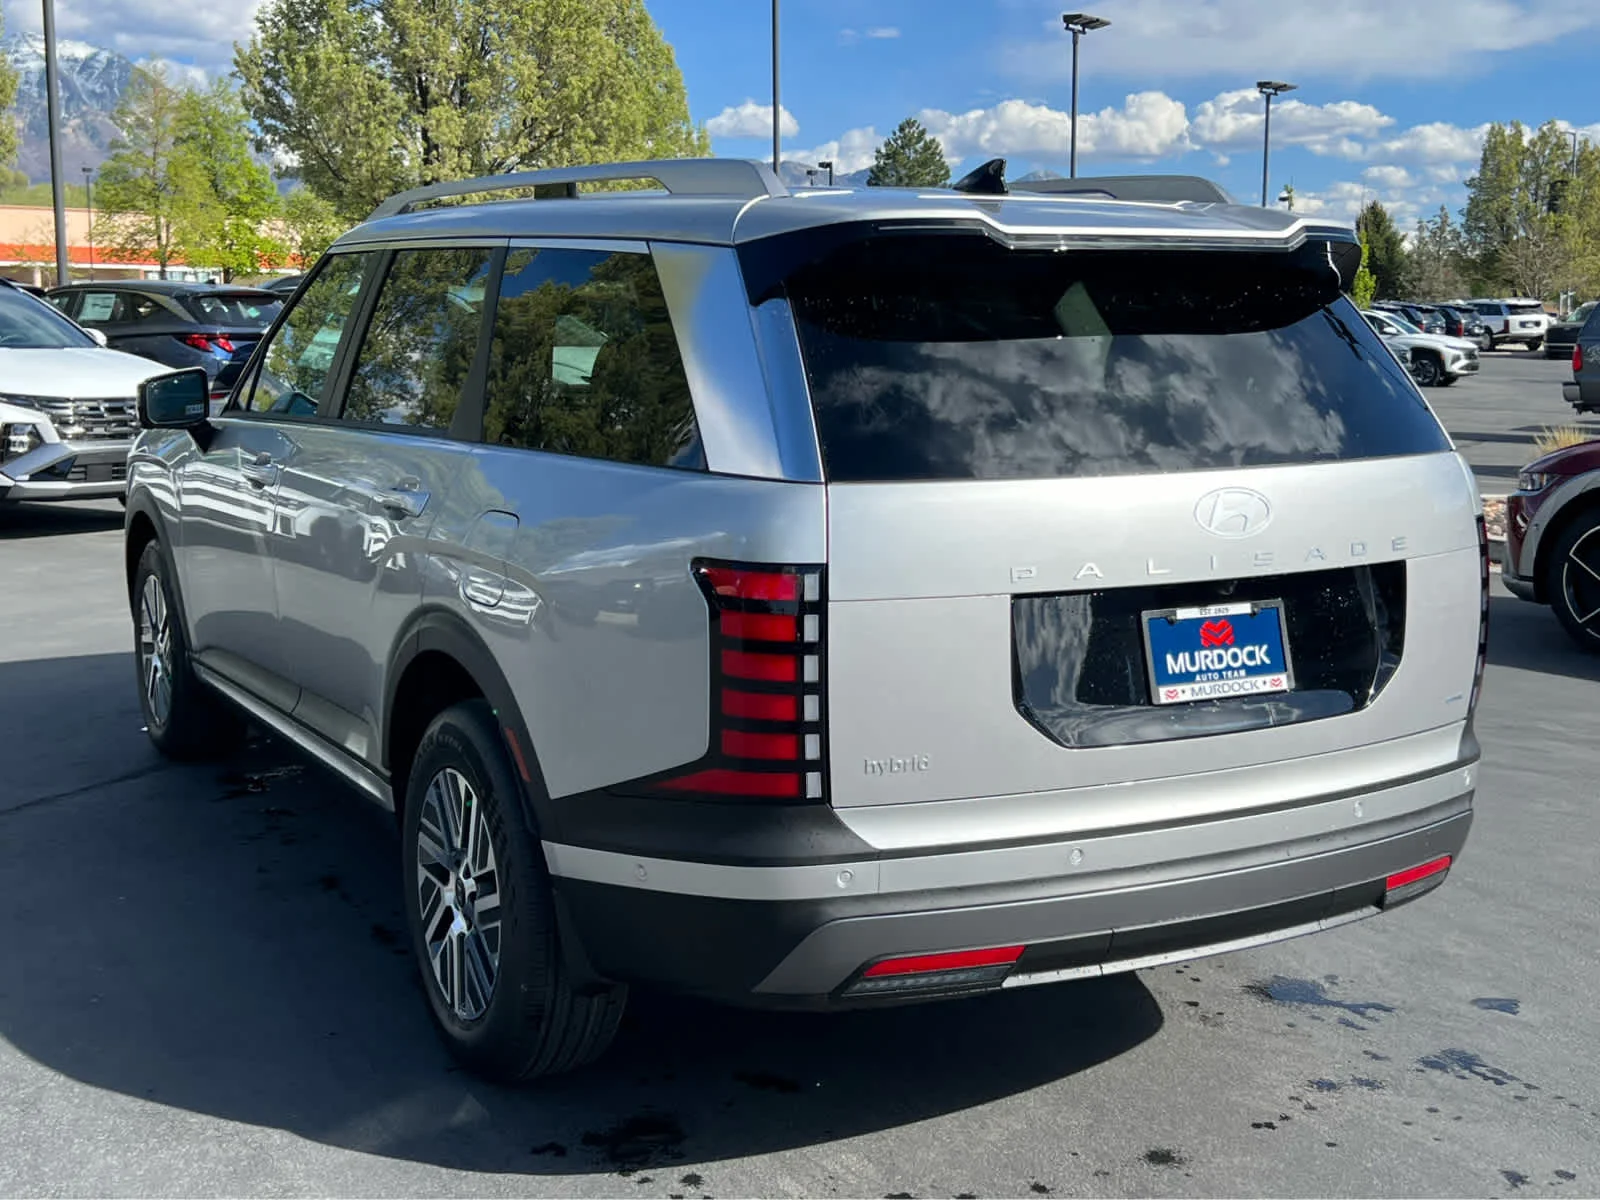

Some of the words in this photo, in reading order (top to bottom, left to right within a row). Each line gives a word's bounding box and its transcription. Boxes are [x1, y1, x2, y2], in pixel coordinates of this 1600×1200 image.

[1009, 536, 1408, 584] PALISADE
[1166, 644, 1271, 675] MURDOCK
[1195, 671, 1220, 682] AUTO
[1222, 668, 1247, 680] TEAM
[1191, 679, 1260, 697] MURDOCK
[863, 753, 930, 776] hybrid
